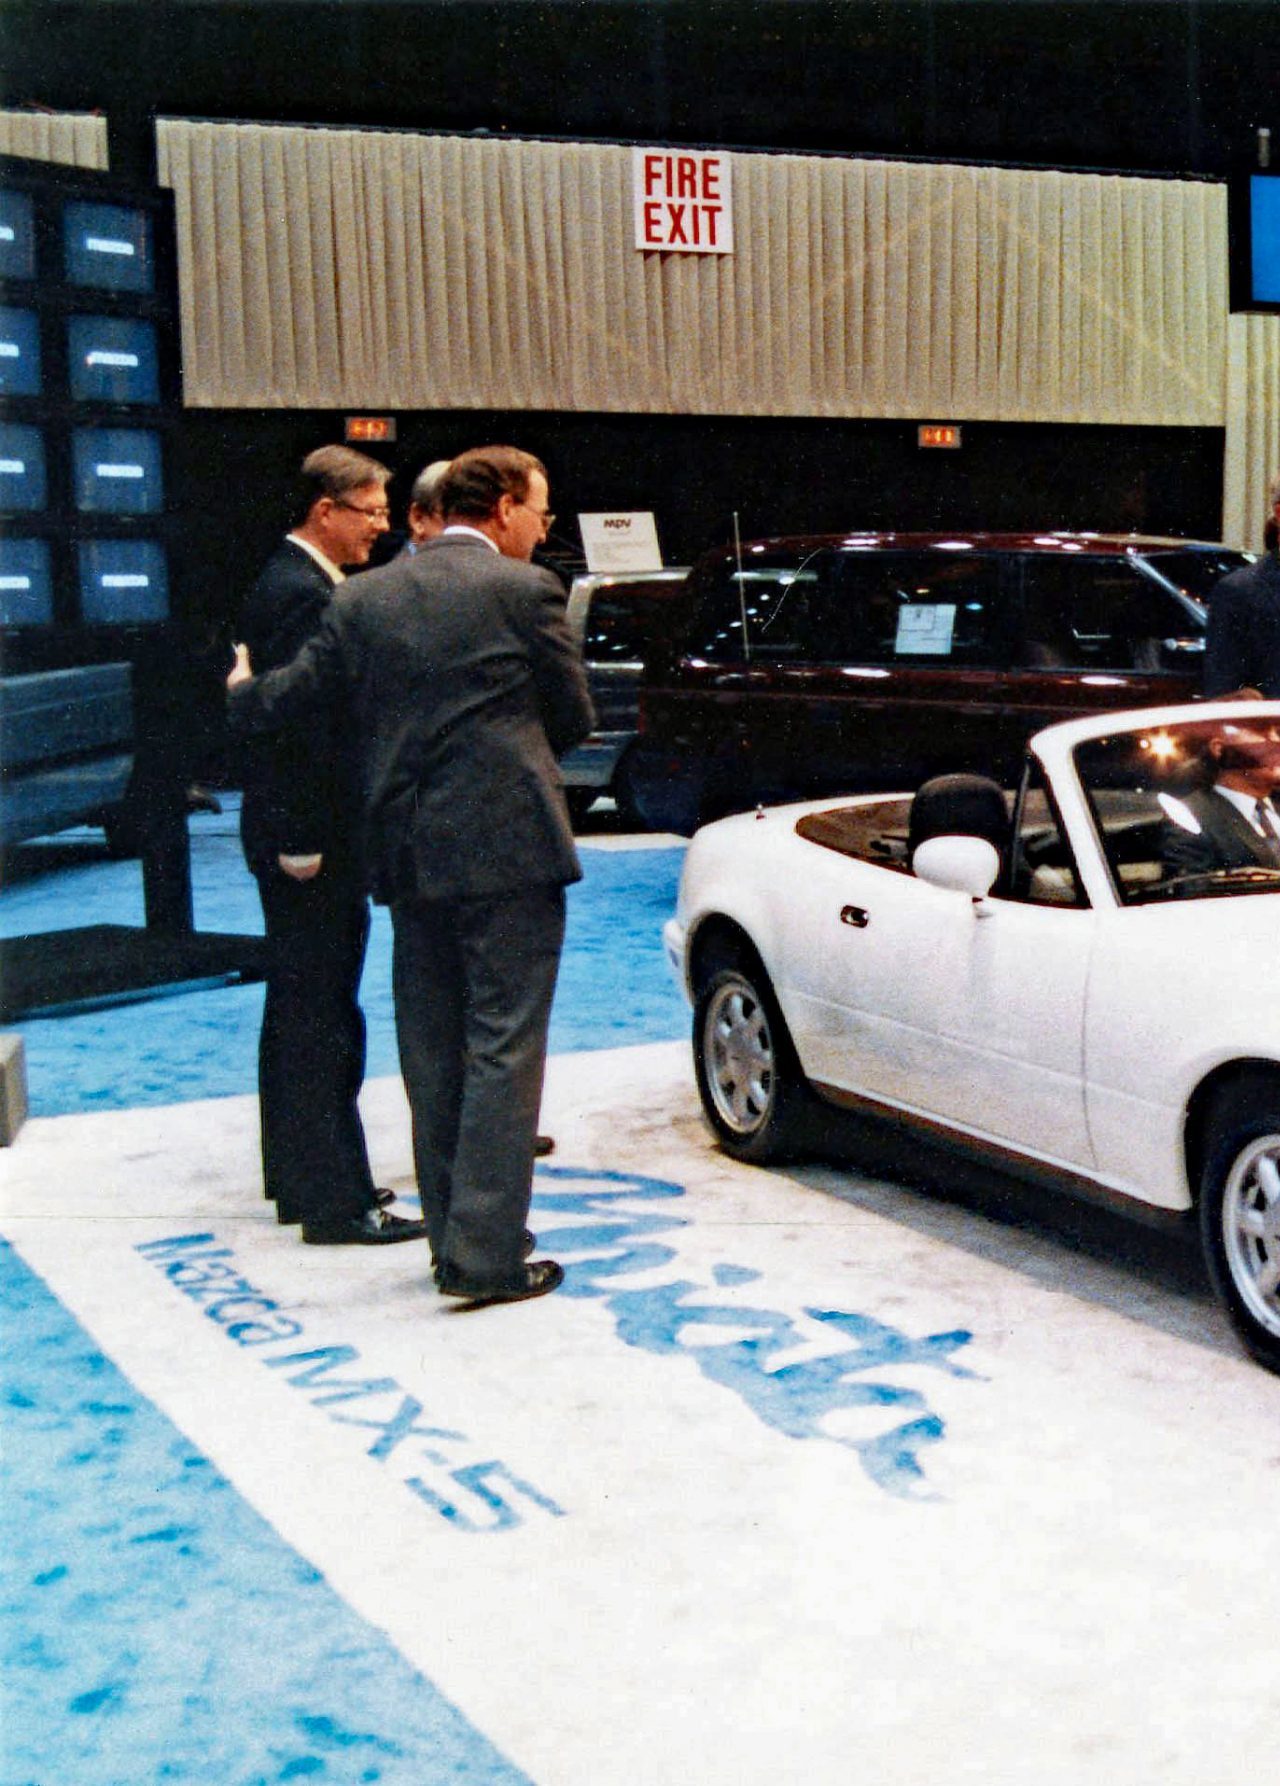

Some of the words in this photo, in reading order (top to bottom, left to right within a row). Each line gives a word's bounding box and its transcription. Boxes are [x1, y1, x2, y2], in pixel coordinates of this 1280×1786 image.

[644, 155, 720, 200] FIRE
[643, 201, 723, 246] EXIT
[132, 1232, 305, 1348] Mazda
[261, 1344, 568, 1534] MX-5
